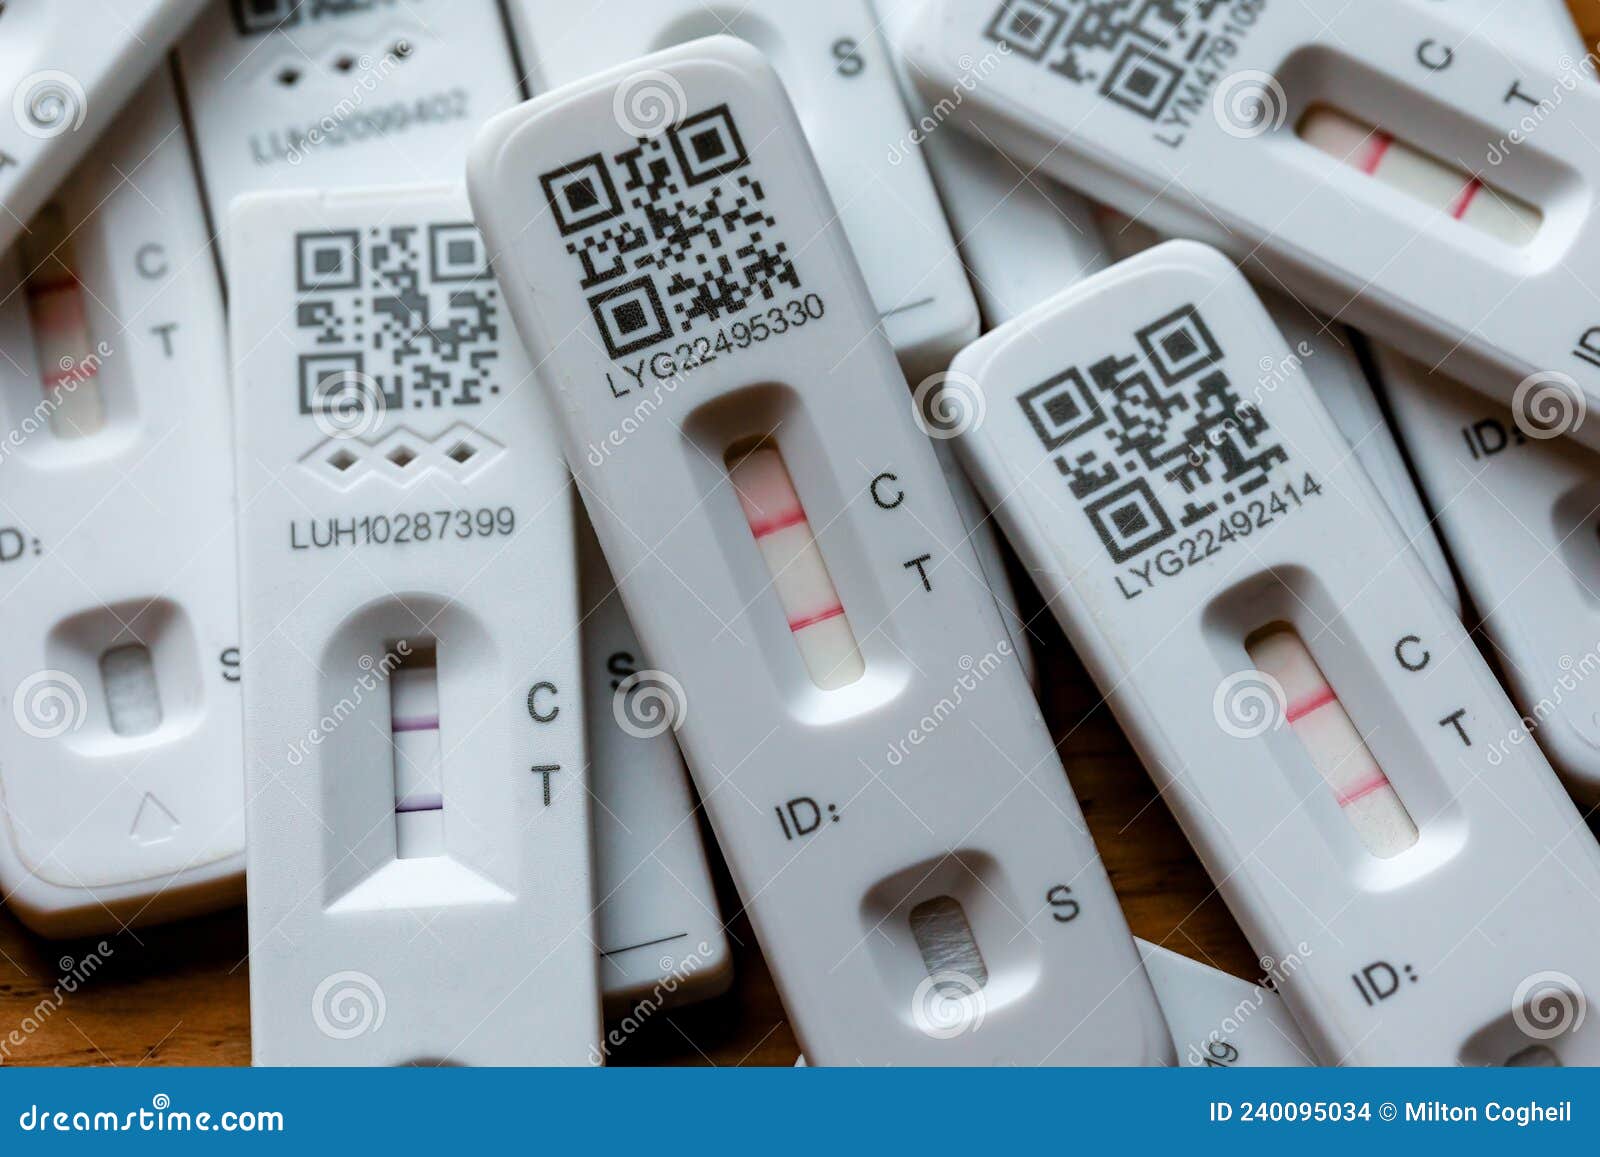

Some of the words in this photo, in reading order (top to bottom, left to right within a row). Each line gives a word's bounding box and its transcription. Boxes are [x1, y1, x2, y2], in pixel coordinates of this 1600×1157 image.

[832, 37, 865, 78] S
[1416, 38, 1454, 71] C
[1504, 80, 1541, 107] T
[136, 243, 168, 280] C
[150, 323, 179, 358] T
[605, 292, 825, 399] LYG22495330
[870, 472, 904, 509] C
[290, 506, 515, 550] LUH10287399
[1115, 471, 1323, 600] LYG22492414
[903, 553, 931, 592] T
[1395, 634, 1431, 672] C
[527, 681, 560, 723] C
[1439, 707, 1473, 747] T
[530, 764, 561, 807] T
[775, 796, 841, 841] ID:
[1046, 884, 1081, 923] S
[1351, 960, 1419, 1007] ID:
